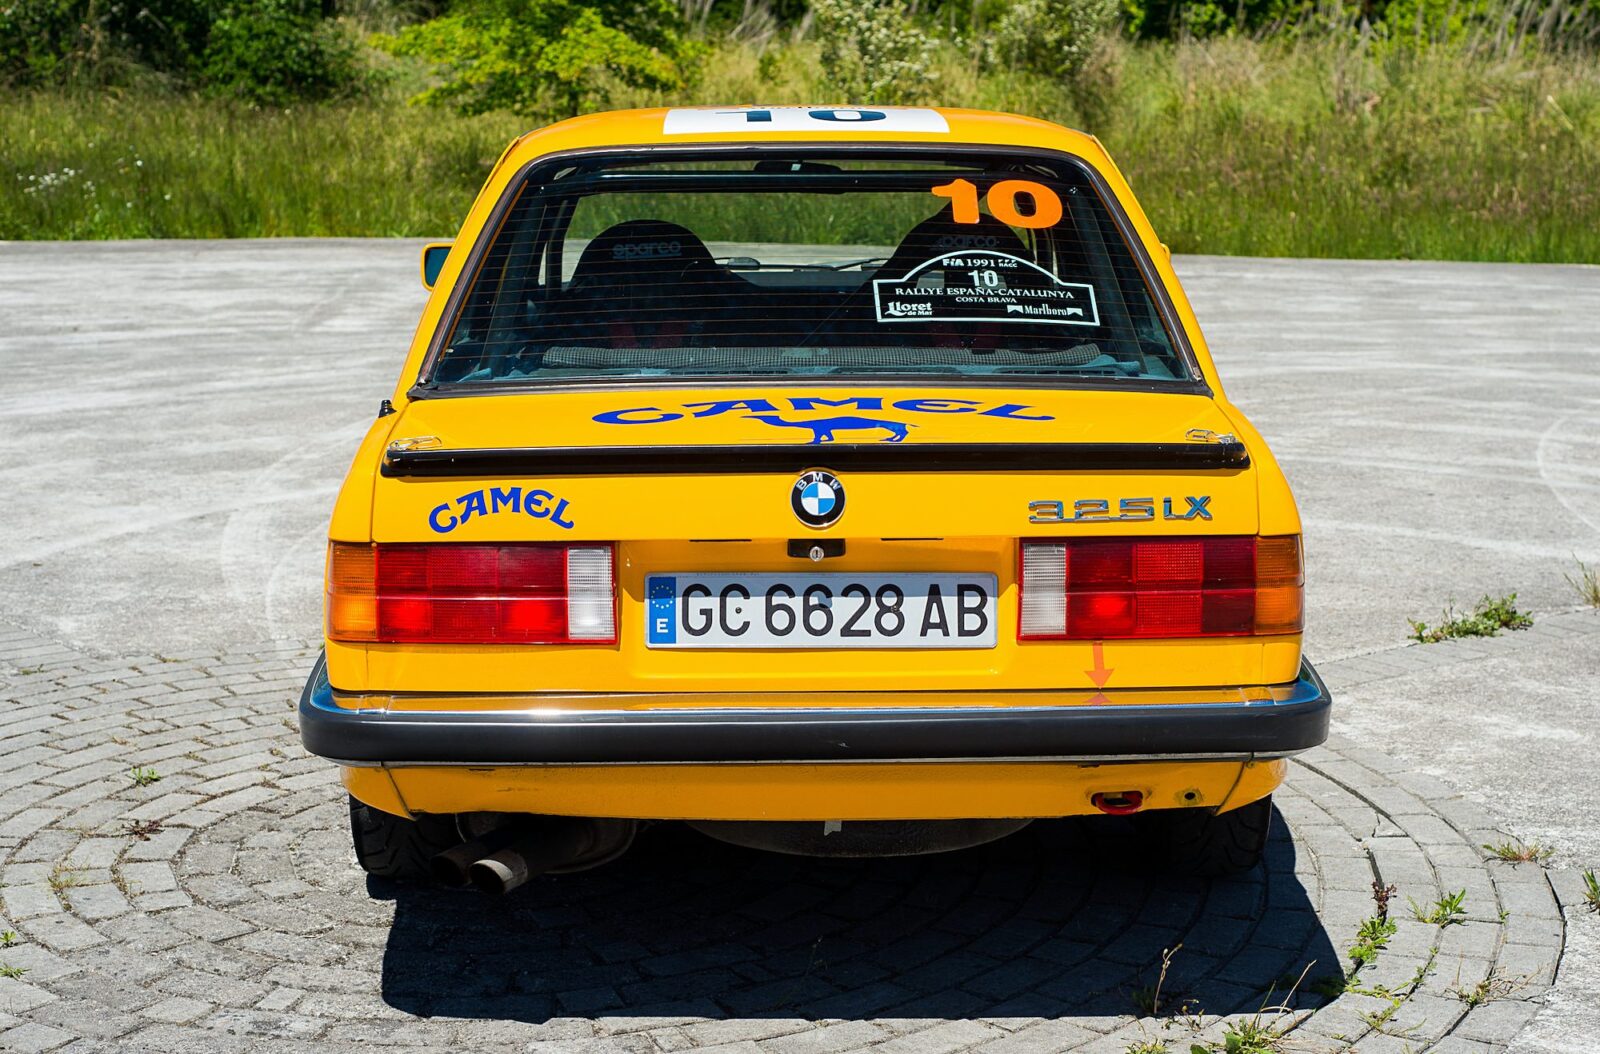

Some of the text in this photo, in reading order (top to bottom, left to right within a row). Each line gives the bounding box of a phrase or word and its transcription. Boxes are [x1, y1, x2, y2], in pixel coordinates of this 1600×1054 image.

[931, 178, 1063, 229] 10
[612, 241, 683, 261] sparco
[966, 259, 996, 267] 1991
[968, 269, 999, 287] 10
[895, 287, 944, 296] RALLYE
[884, 301, 933, 316] Lloret
[1024, 303, 1068, 316] Marlboro
[592, 397, 1056, 425] CAMEL
[796, 472, 842, 491] BMW
[428, 486, 575, 534] CAMEL
[682, 583, 988, 637] GC 6628 AB
[656, 617, 669, 634] E
